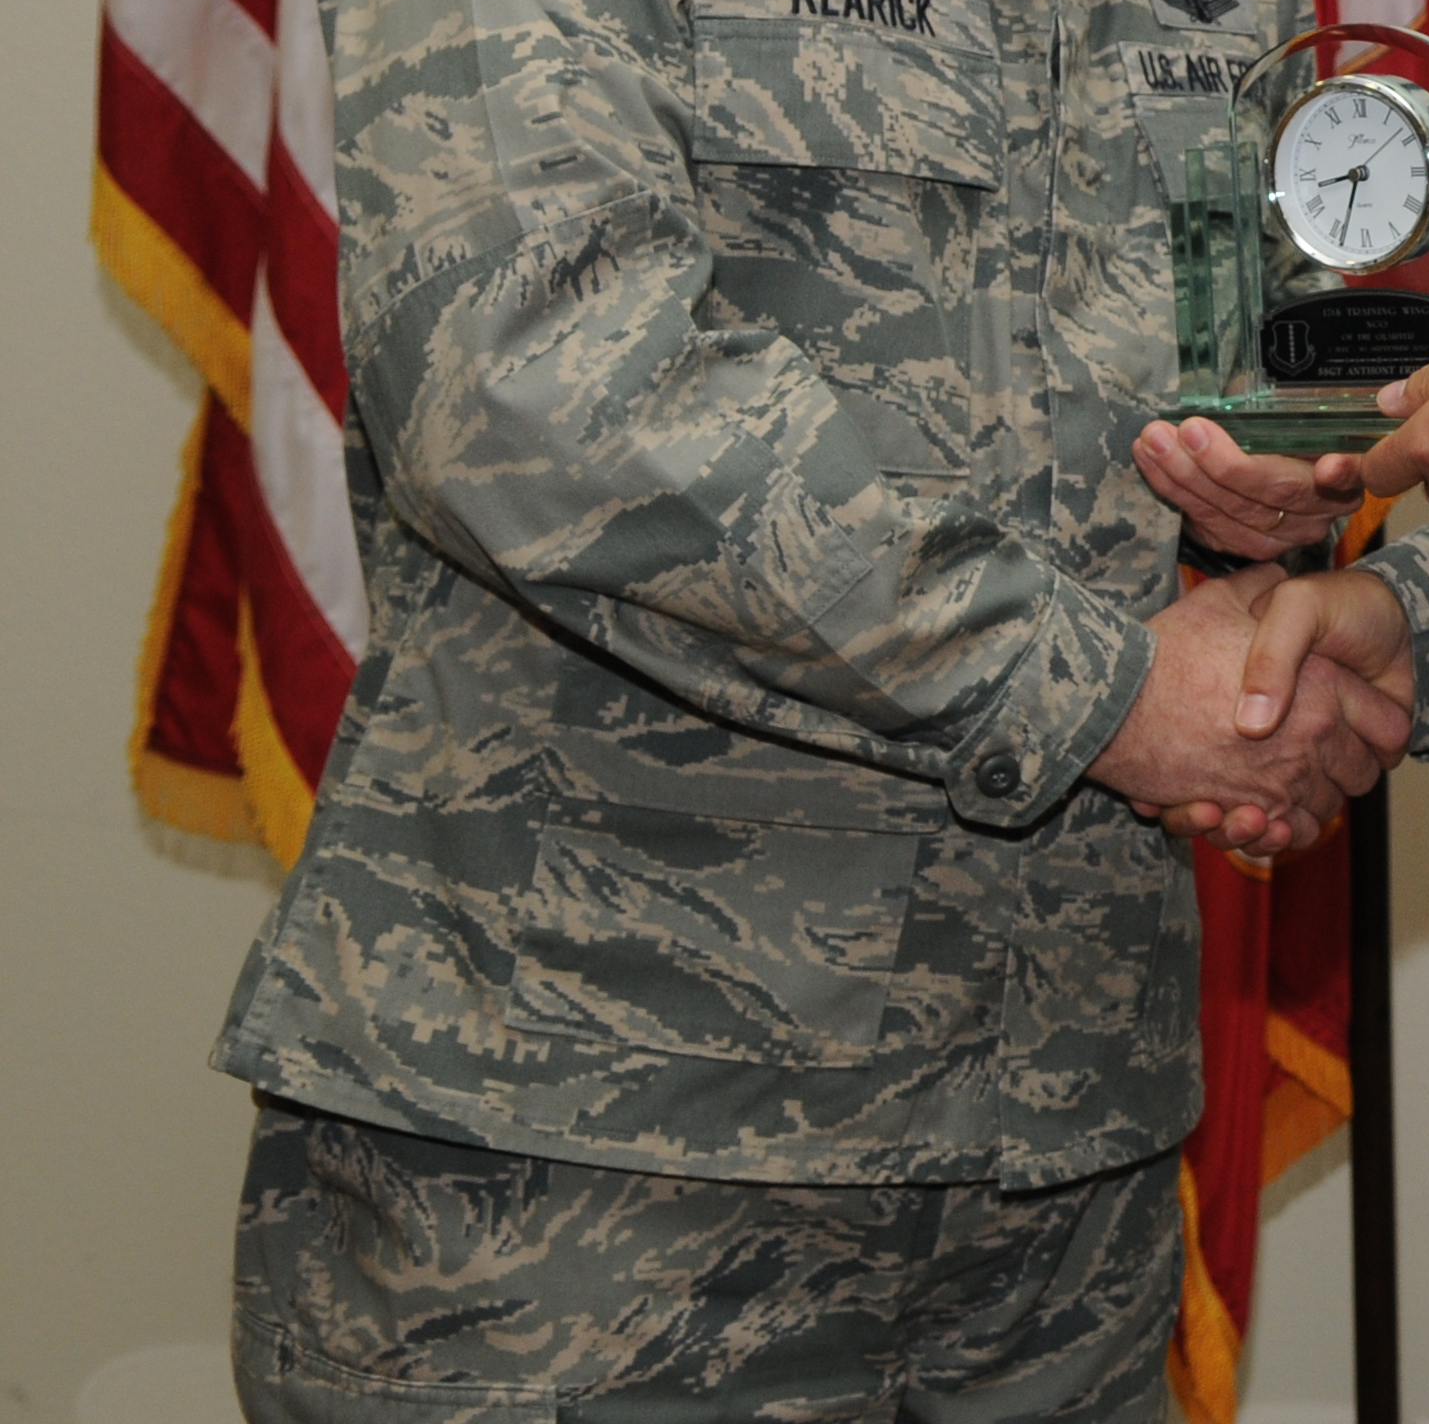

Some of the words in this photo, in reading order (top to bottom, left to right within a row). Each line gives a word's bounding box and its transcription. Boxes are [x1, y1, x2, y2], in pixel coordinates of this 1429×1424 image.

[1138, 49, 1184, 91] U.S.
[1185, 53, 1229, 94] AIR
[1346, 306, 1397, 317] TRAINING
